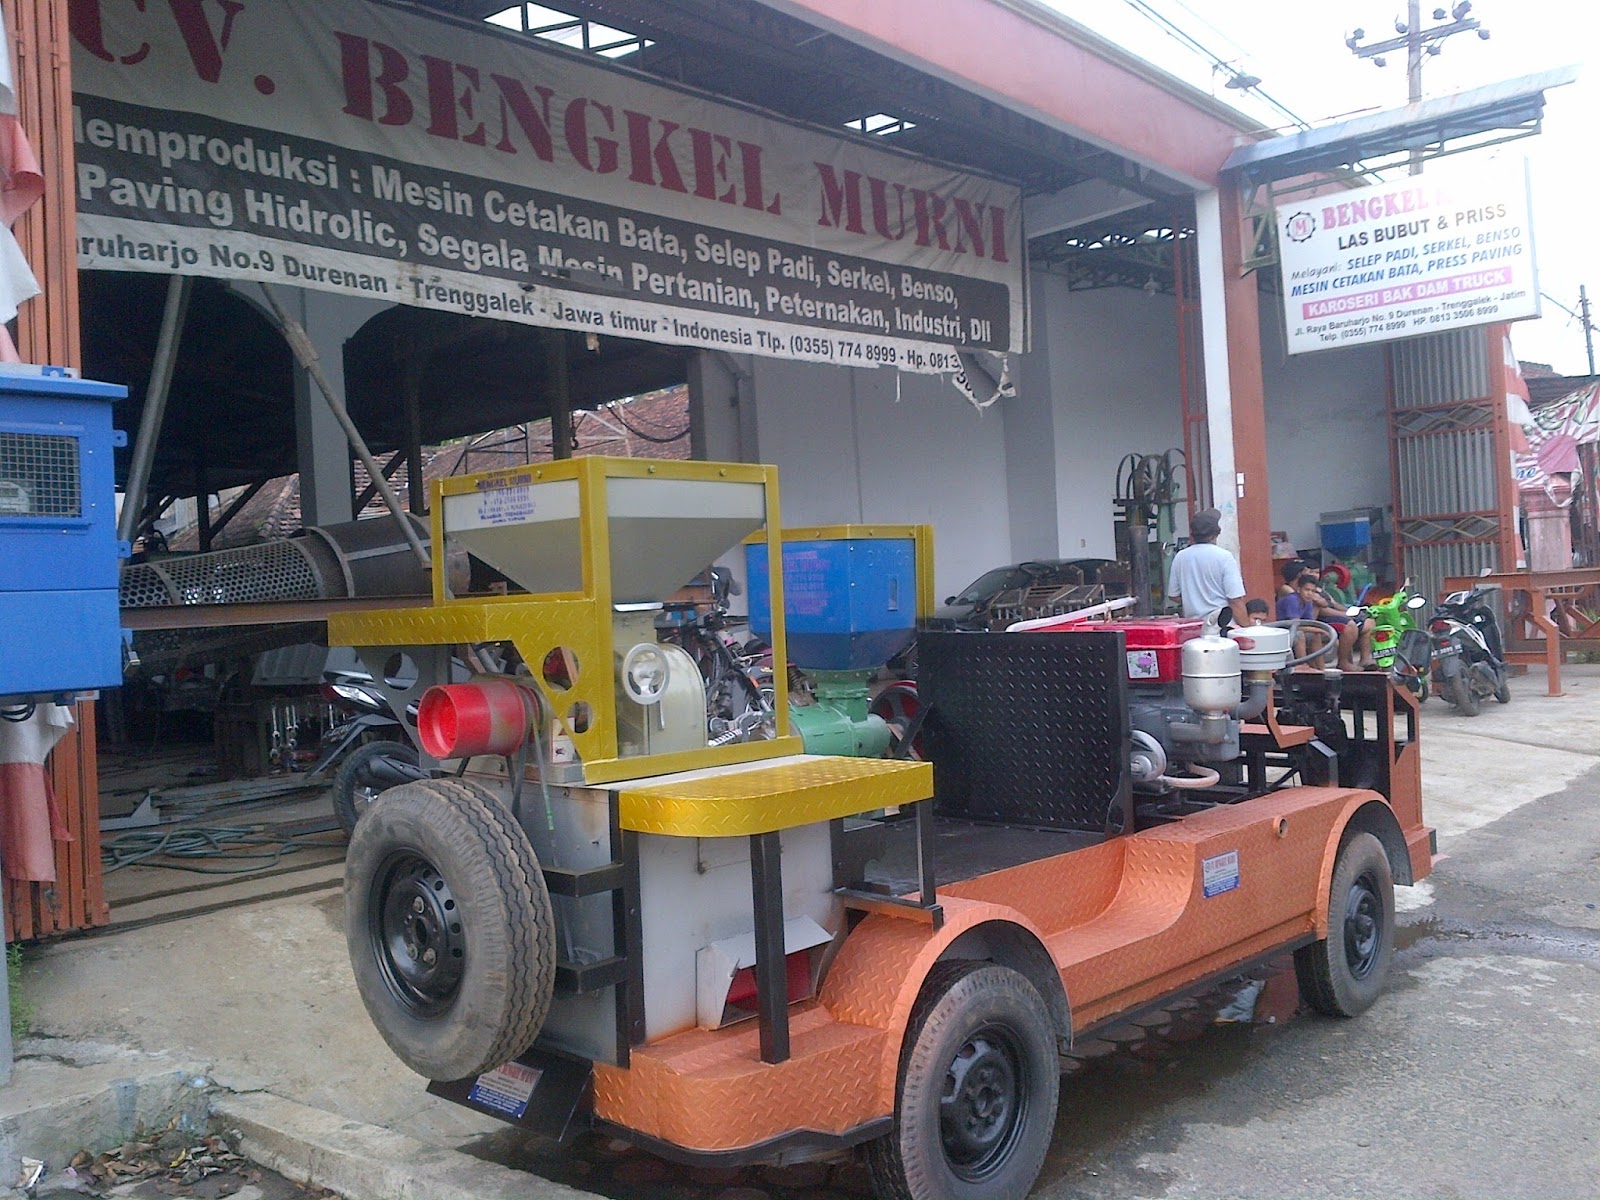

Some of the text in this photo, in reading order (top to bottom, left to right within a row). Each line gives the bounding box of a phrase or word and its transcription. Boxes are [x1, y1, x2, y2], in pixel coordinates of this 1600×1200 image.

[334, 31, 781, 216] BENGKEL
[814, 161, 1009, 263] MURNI
[1322, 188, 1429, 230] BENGKEL
[1338, 203, 1506, 250] LAS BUBUT & PRISS
[78, 162, 234, 227] Paving
[244, 188, 407, 258] Hidrolic,
[418, 222, 529, 273] Segala
[631, 262, 760, 315] Pertanian,
[765, 286, 890, 333] Peternakan,
[895, 307, 966, 344] Industri,
[372, 164, 473, 217] Mesin
[484, 190, 610, 243] Cetakan
[618, 216, 687, 264] Bata,
[695, 233, 761, 277] Selep
[767, 247, 821, 288] Padi,
[828, 260, 896, 299] Serkel,
[901, 273, 959, 310] Benso,
[1291, 227, 1520, 279] Melayani: SELEP PADI, SERKEL, BENSO
[1291, 244, 1522, 297] MESIN CETAKAN BATA, PRESS PAVING
[1308, 270, 1506, 317] KAROSERI BAK DAM TRUCK
[209, 244, 275, 272] No.9
[282, 254, 389, 294] Durenan
[409, 276, 535, 316] Trenggalek
[553, 301, 604, 327] Jawa
[611, 310, 657, 334] timur
[673, 318, 752, 347] Indonesia
[757, 330, 785, 353] Tlp.
[789, 333, 833, 360] (0355)
[838, 340, 863, 360] 774
[866, 344, 896, 364] 8999
[907, 350, 926, 370] Hp.
[929, 352, 960, 369] 0813
[1307, 324, 1327, 334] Raya
[1329, 317, 1370, 330] Baruharjo
[1396, 306, 1434, 318] Durenan
[1441, 296, 1492, 311] Trenggalek
[1500, 290, 1526, 301] Jatim
[1369, 324, 1384, 333] 774
[1429, 313, 1451, 323] 0813
